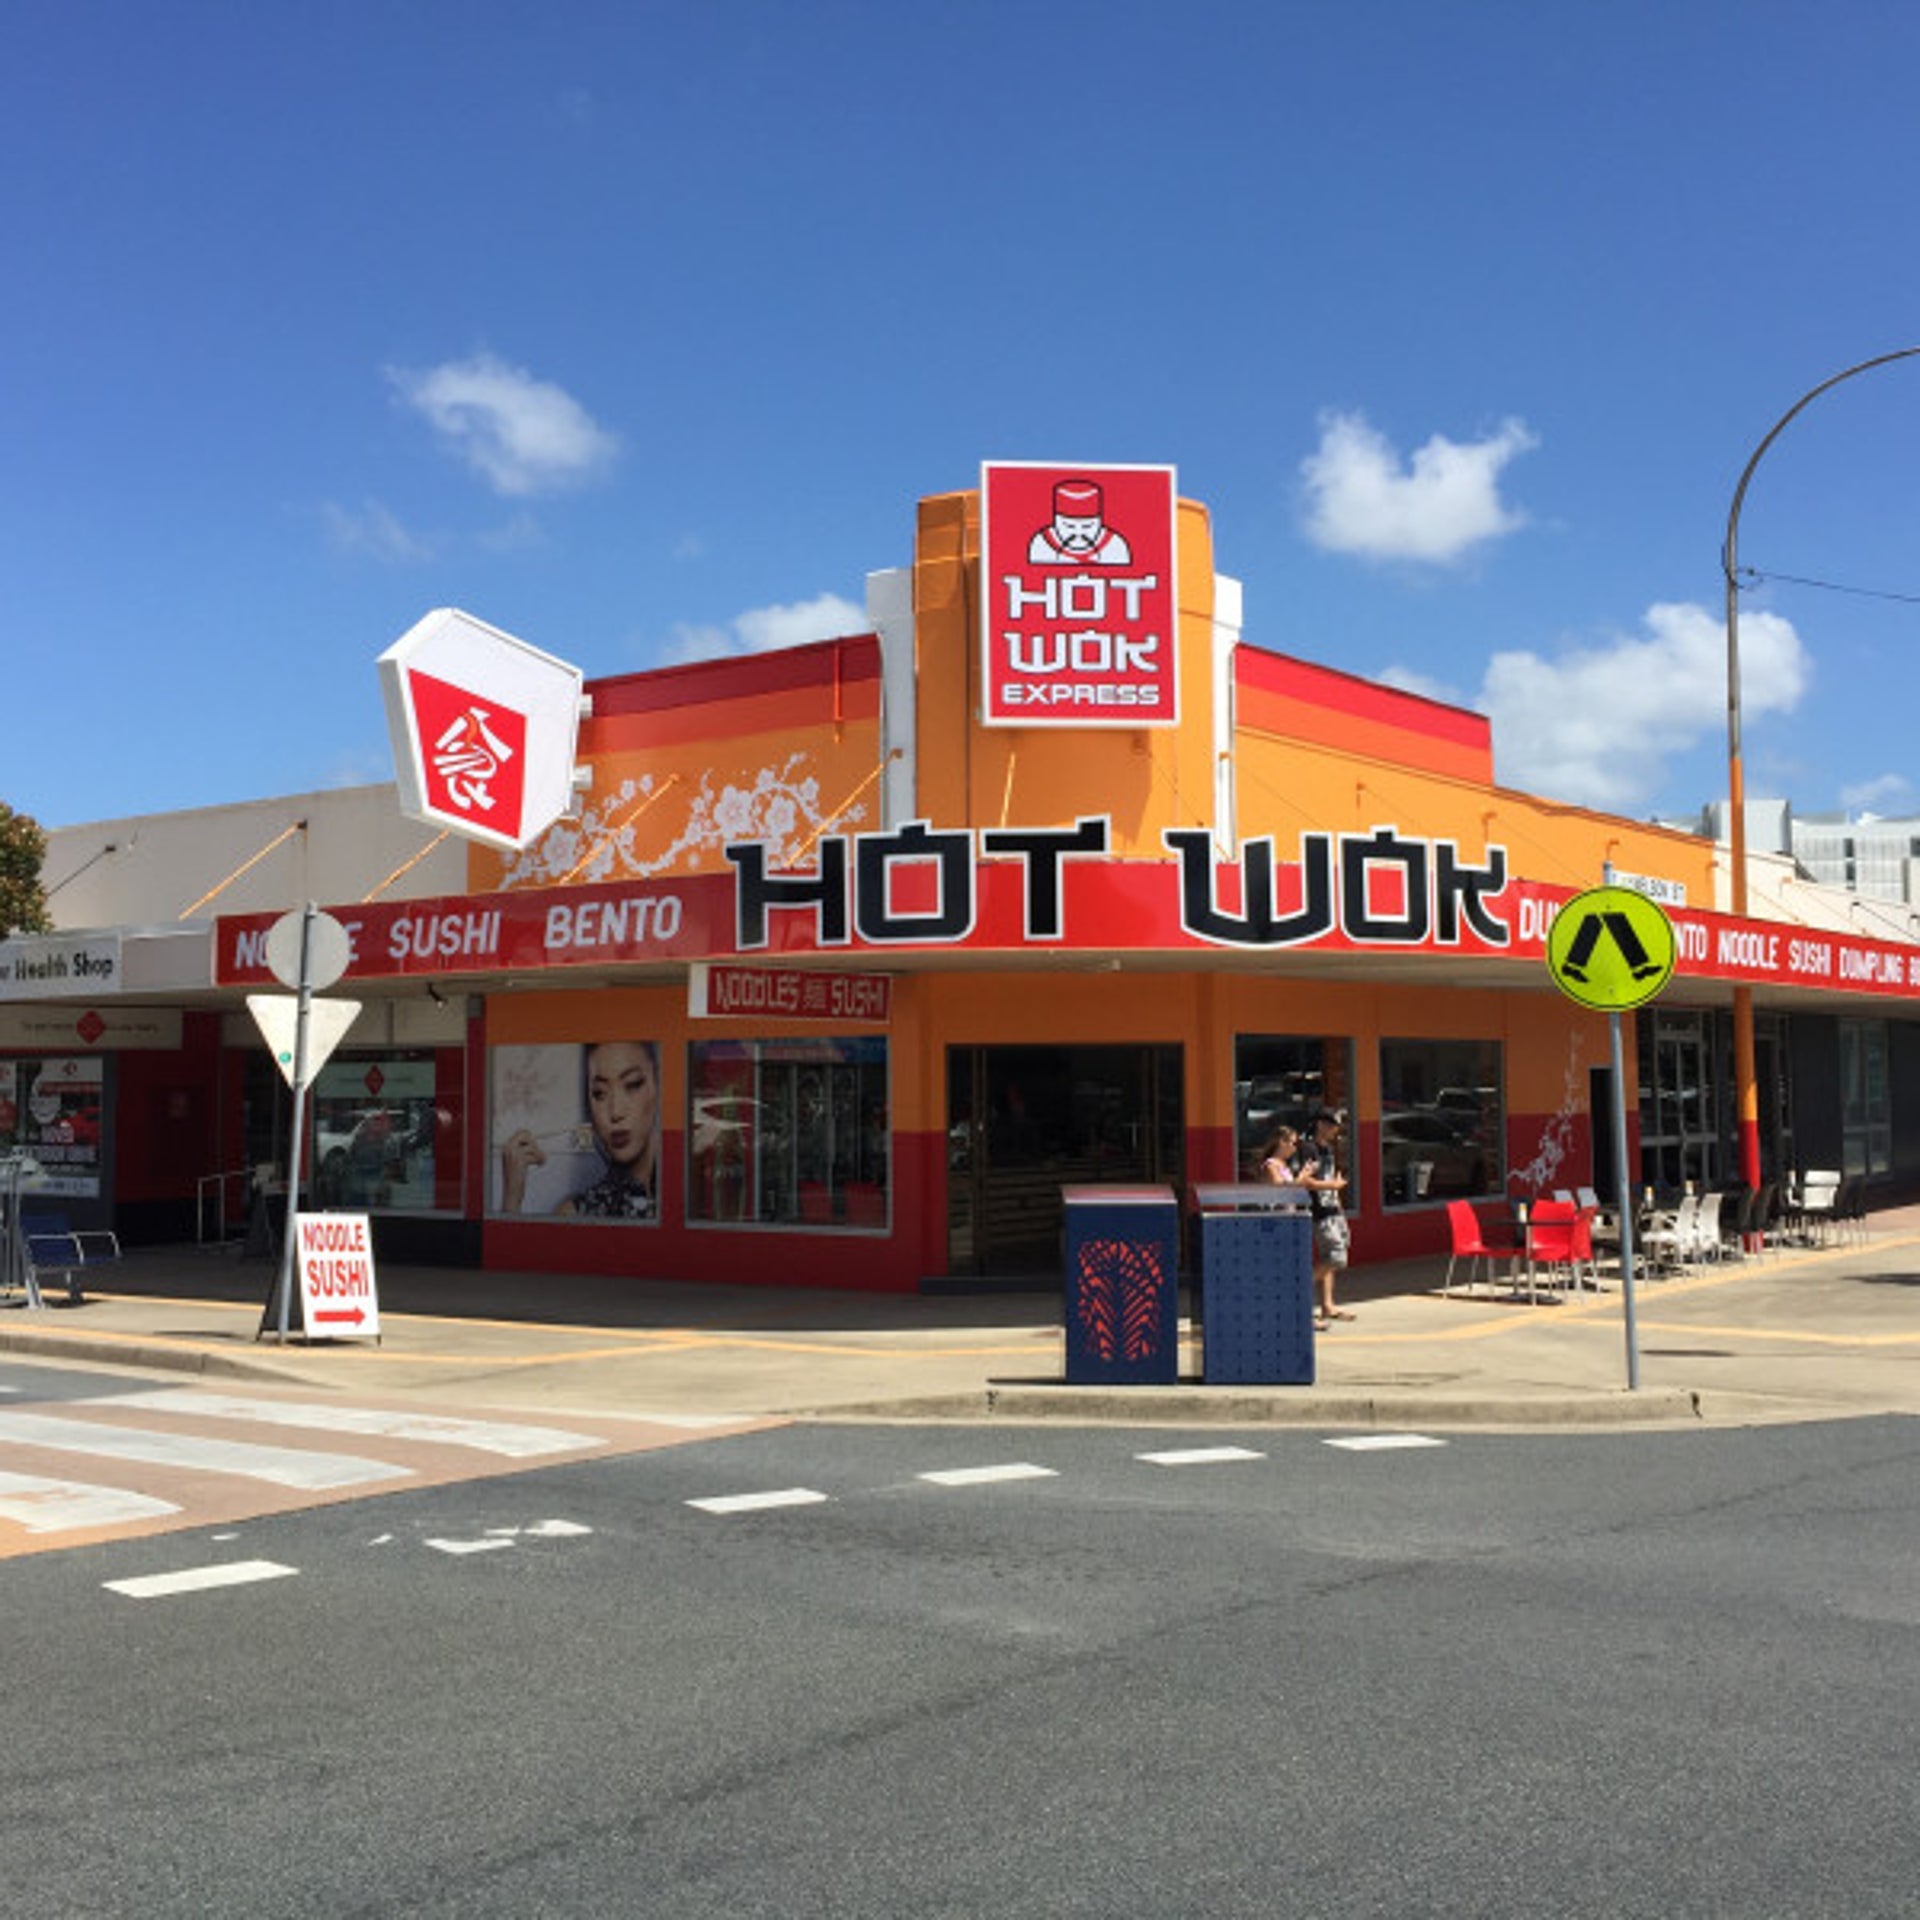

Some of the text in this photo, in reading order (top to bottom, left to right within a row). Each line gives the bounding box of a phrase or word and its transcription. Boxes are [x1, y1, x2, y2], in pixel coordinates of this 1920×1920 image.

[1003, 573, 1158, 621] HOT
[1003, 629, 1159, 674] WOK
[1002, 683, 1160, 705] EXPRESS
[725, 814, 1510, 952] HOT WOK
[388, 911, 501, 958] SUSHI
[544, 895, 682, 949] BENTO
[15, 952, 68, 982] Health
[73, 950, 114, 980] Shop
[1717, 929, 1780, 970] NOODLE
[1788, 938, 1832, 977] SUSHI
[1838, 946, 1904, 985] DUMPLING
[714, 970, 800, 1011] NOODLES
[831, 976, 885, 1014] SUSHI
[303, 1222, 366, 1252] NOODLE
[307, 1259, 370, 1297] SUSHI
